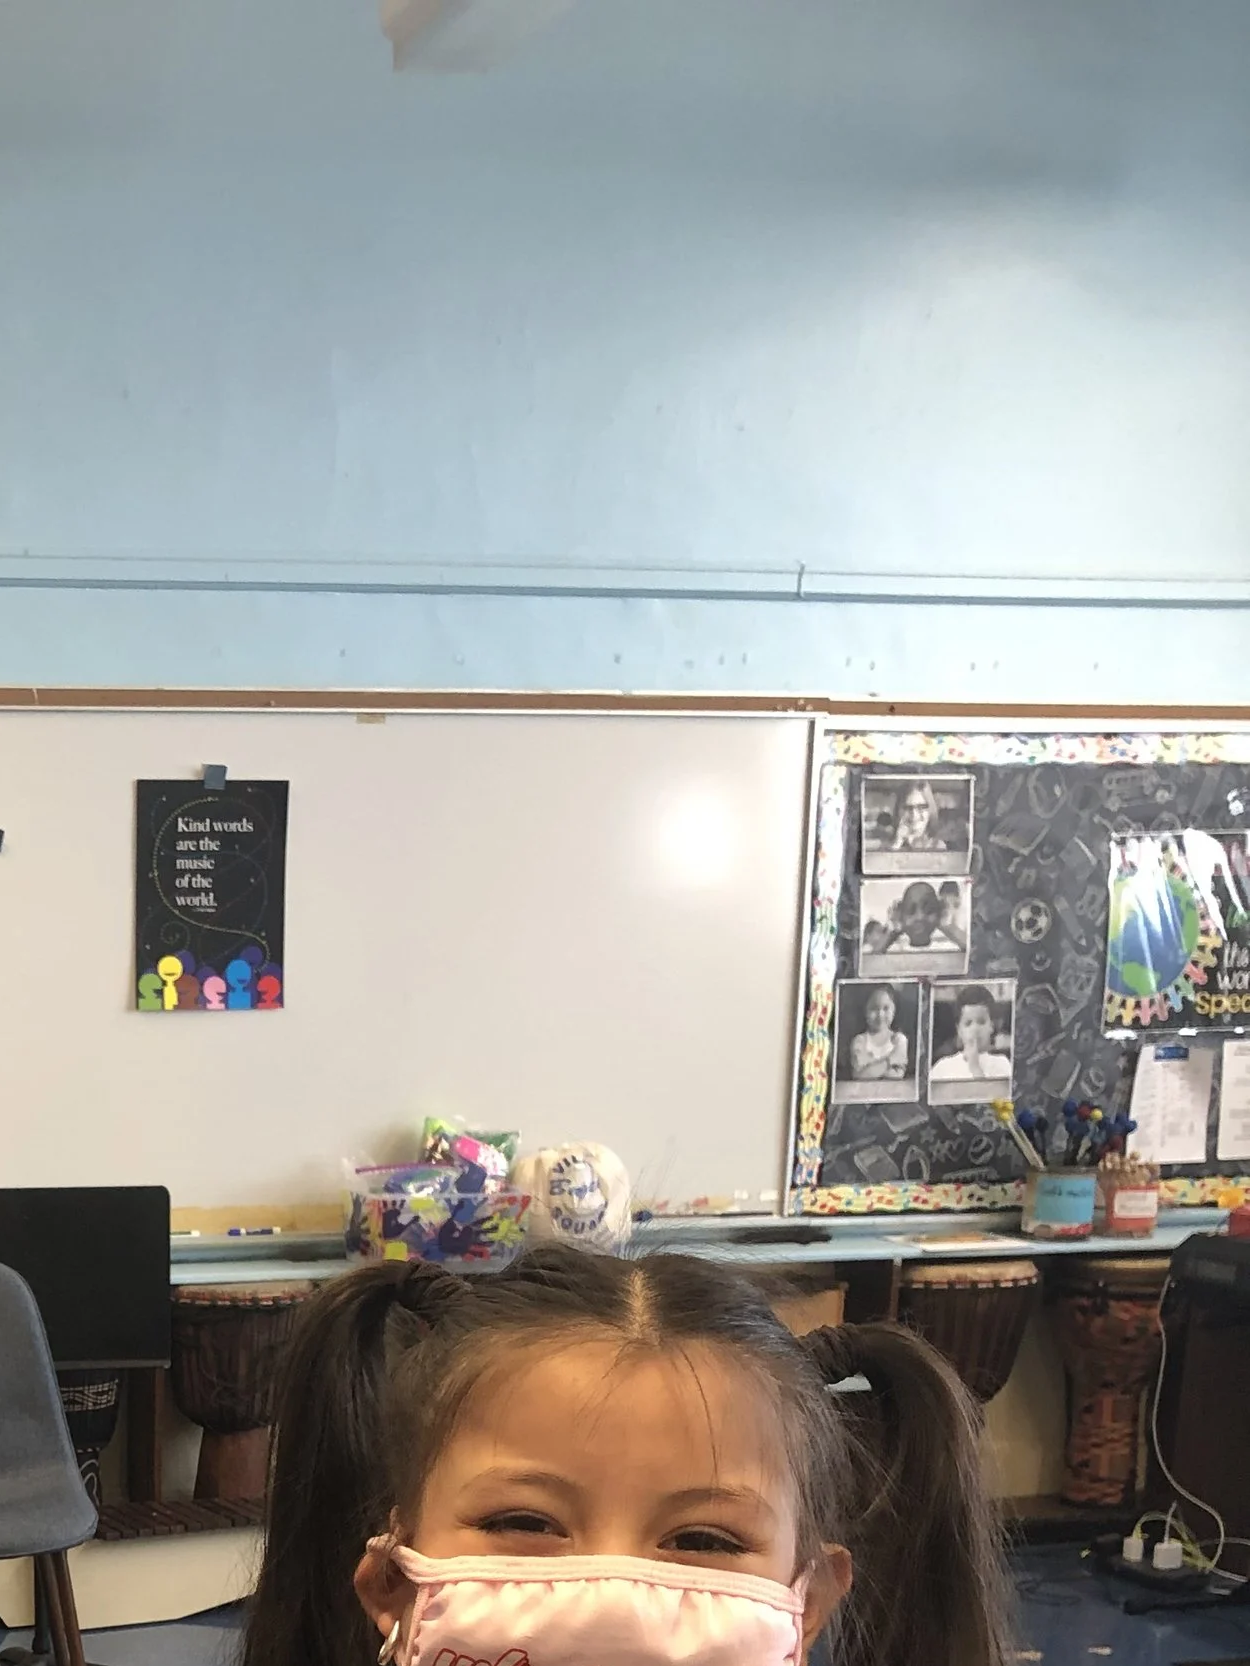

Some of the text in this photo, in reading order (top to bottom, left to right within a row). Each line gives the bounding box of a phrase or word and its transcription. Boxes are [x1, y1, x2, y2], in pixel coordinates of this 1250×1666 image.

[177, 817, 254, 833] Kind words
[176, 837, 220, 851] are the
[176, 856, 215, 870] music
[175, 874, 212, 888] of the
[175, 893, 217, 907] world.
